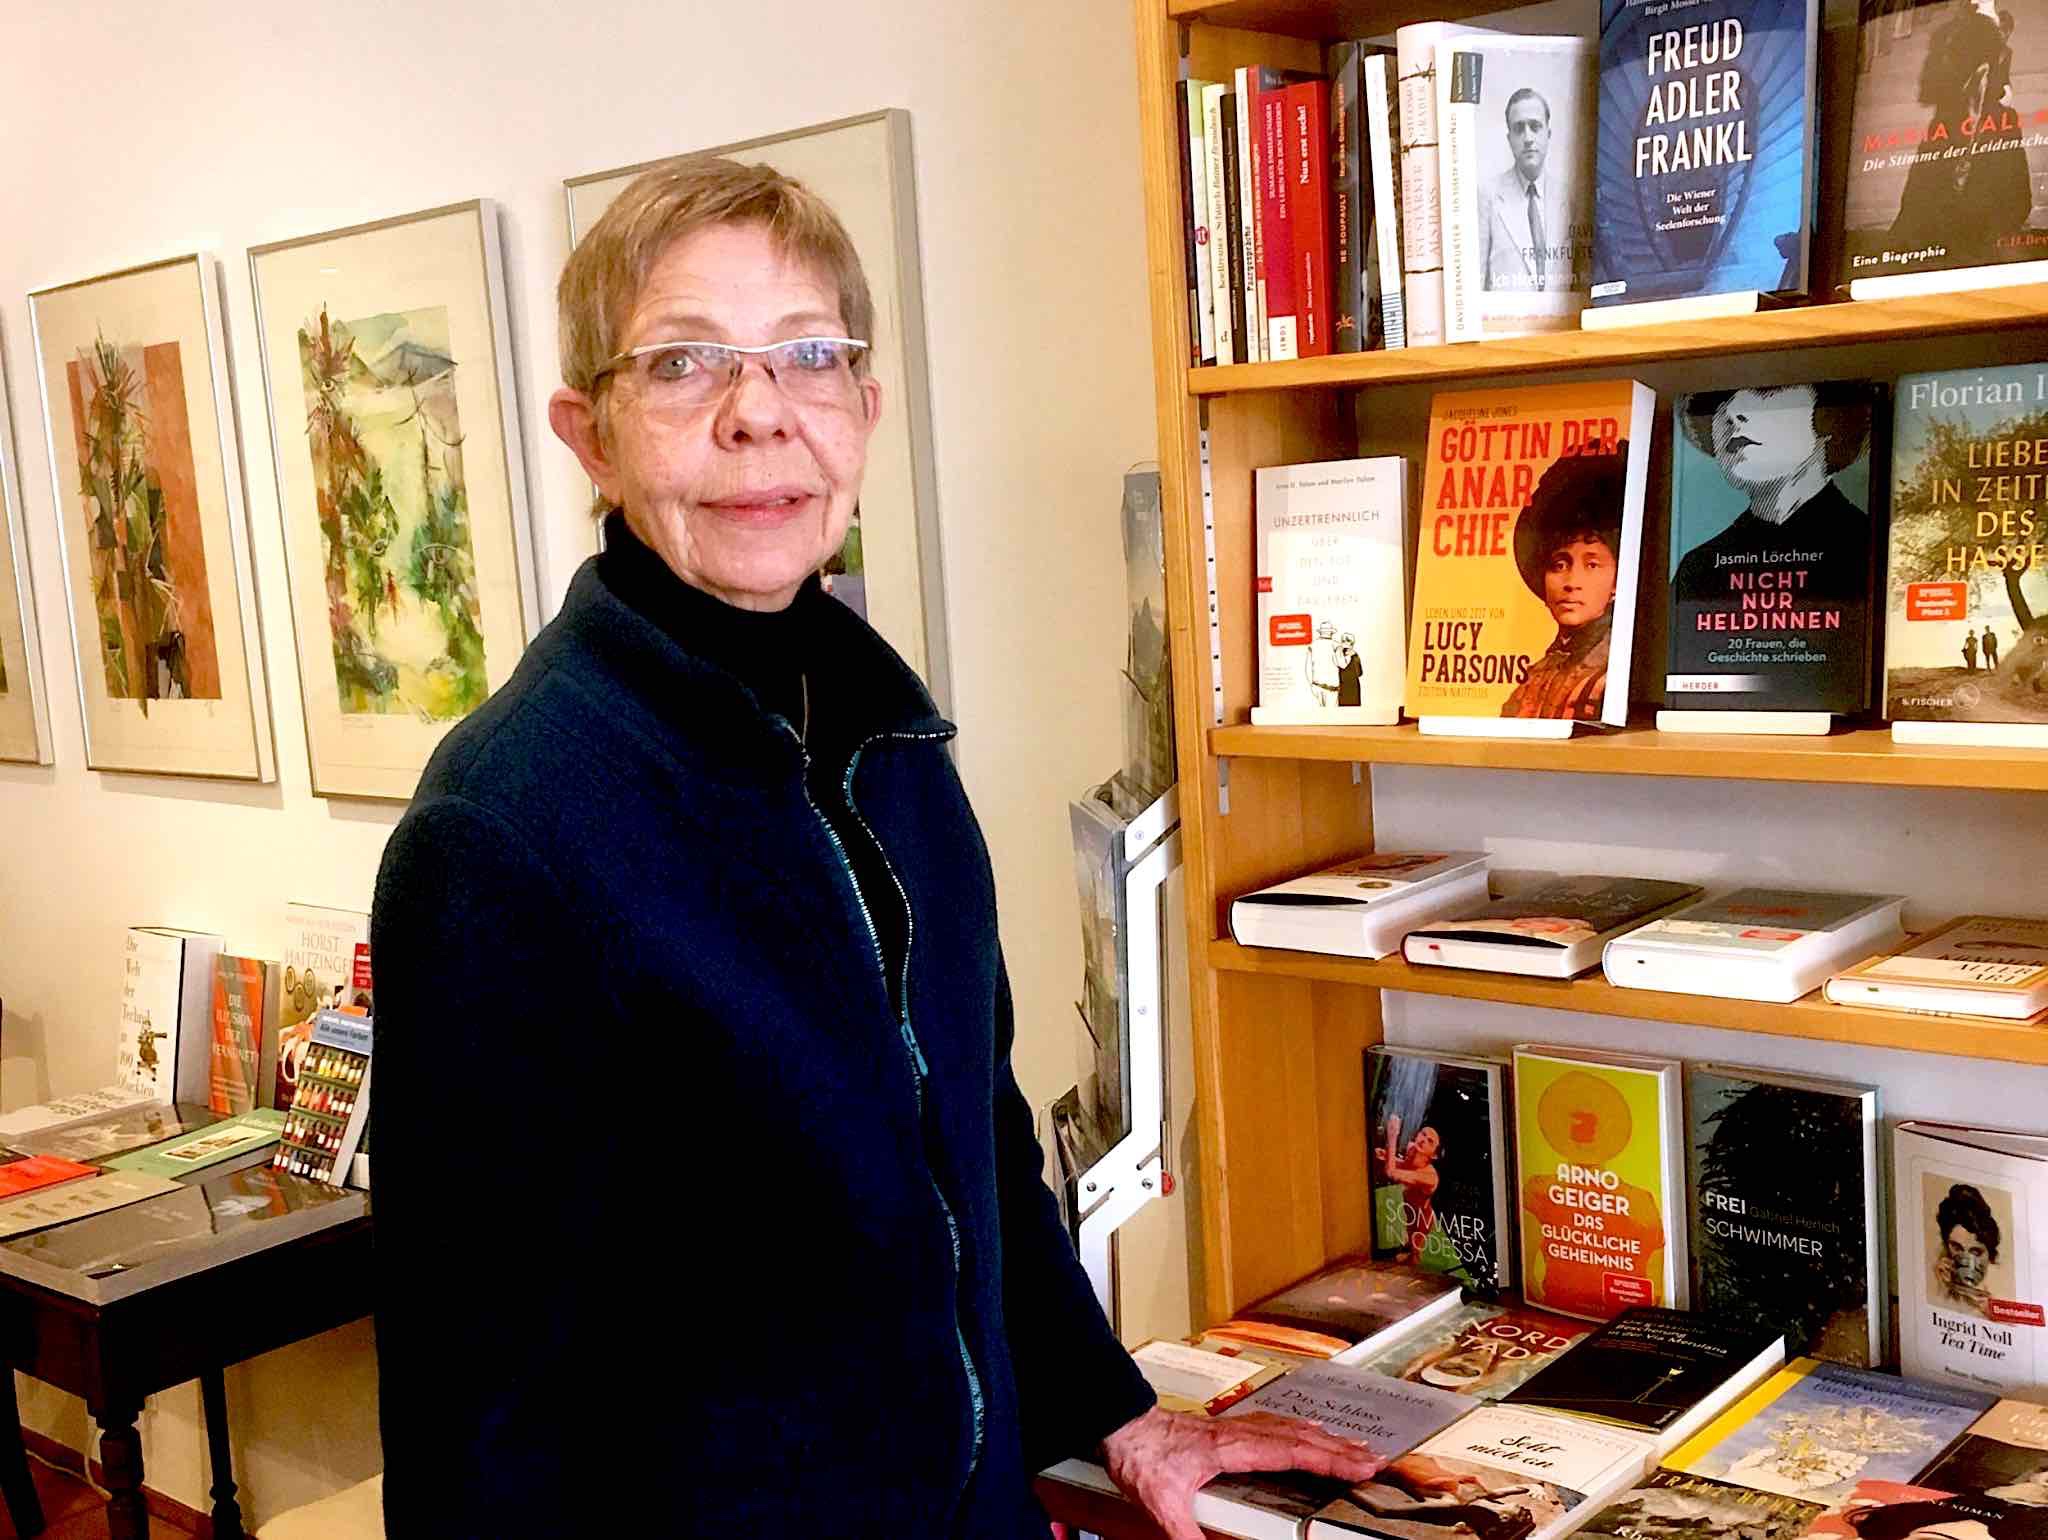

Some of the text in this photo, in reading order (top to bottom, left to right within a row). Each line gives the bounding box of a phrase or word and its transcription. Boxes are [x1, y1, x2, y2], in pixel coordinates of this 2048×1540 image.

[1648, 18, 1743, 76] FREUD
[1645, 70, 1741, 126] ADLER
[1635, 120, 1752, 178] FRANKL
[1863, 158, 1885, 172] Die
[1888, 150, 1940, 169] Stimme
[1943, 145, 1969, 159] der
[1299, 160, 1310, 185] Nun
[1666, 189, 1716, 203] Die Wiener
[1672, 202, 1710, 215] Welt der
[1655, 215, 1727, 231] Seelenforschung
[1852, 245, 1946, 267] Eine Biographie
[1911, 376, 2022, 410] Florian
[1440, 418, 1618, 464] GÖTTIN DER
[1968, 438, 2048, 468] LIEBE
[1436, 464, 1533, 509] ANAR
[1932, 473, 2048, 504] IN ZEIT
[1273, 509, 1380, 528] UNZERTRENNLICH
[1976, 509, 2034, 537] DES
[1433, 513, 1510, 556] CHIE
[1714, 550, 1823, 568] Jasmin Lörchner
[1947, 543, 2045, 572] HASSE
[1730, 571, 1808, 590] NICHT
[1742, 592, 1793, 610] NUR
[1696, 611, 1840, 631] HELDINNEN
[1424, 622, 1483, 651] LUCY
[1728, 637, 1806, 650] 20 Frauen, die
[1421, 653, 1530, 685] PARSONS
[1708, 651, 1827, 663] Geschichte schrieben
[1682, 681, 1719, 690] HERDER
[302, 930, 340, 952] HORST
[1557, 1163, 1619, 1190] ARNO
[1548, 1184, 1629, 1217] GEIGER
[1705, 1190, 1746, 1215] FREI
[1385, 1198, 1486, 1242] SOMMER
[1573, 1212, 1604, 1231] DAS
[1412, 1231, 1489, 1265] ODESSA
[1541, 1223, 1641, 1255] GLÜCKLICHE
[1705, 1217, 1823, 1258] SCHWIMMER
[1548, 1243, 1634, 1272] GEHEIMNIS
[1932, 1312, 2012, 1346] Ingrid Noll
[1940, 1332, 2006, 1360] Tea Time
[1254, 1396, 1400, 1439] der Schriftsteller
[1282, 1389, 1385, 1422] Das Schloss
[1467, 1443, 1554, 1469] mich an
